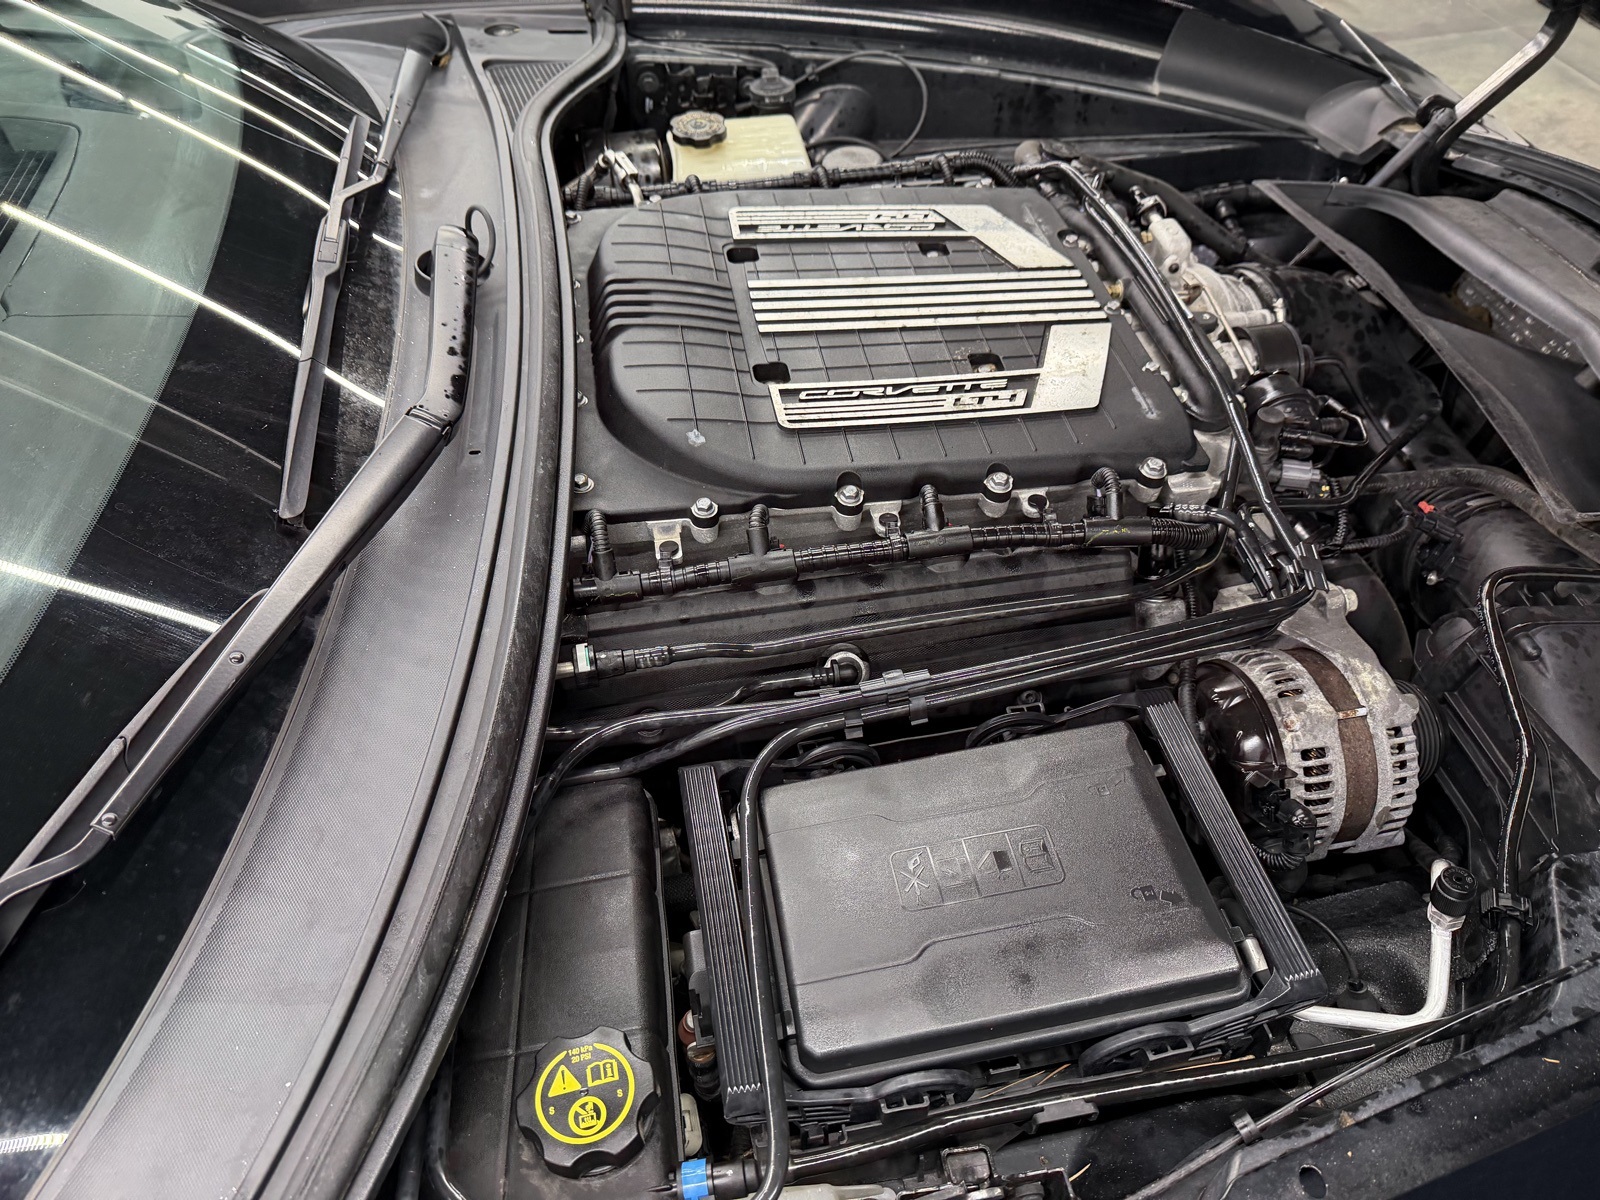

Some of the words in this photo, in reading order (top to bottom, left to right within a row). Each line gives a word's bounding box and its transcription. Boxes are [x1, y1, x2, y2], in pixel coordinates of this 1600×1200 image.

[799, 379, 1008, 400] CORVETTE
[568, 1047, 579, 1056] 140
[581, 1045, 593, 1053] kPa
[571, 1055, 579, 1064] 20
[581, 1052, 592, 1061] PSI
